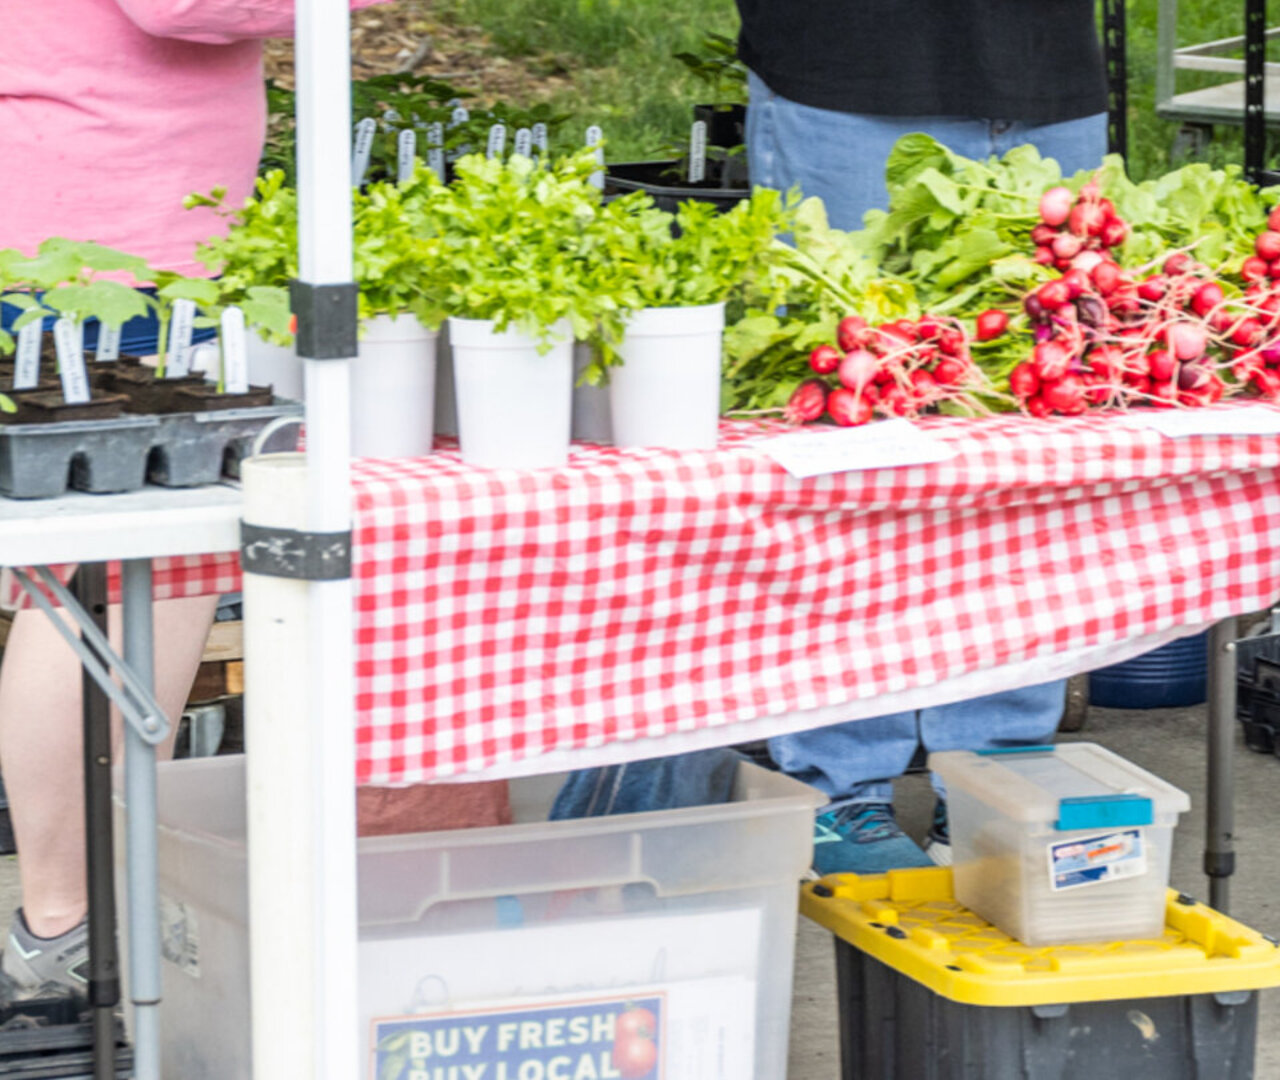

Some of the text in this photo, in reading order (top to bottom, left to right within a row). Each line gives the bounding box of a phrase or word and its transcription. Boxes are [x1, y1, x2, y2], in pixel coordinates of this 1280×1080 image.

[409, 1012, 617, 1060] BUY FRESH
[496, 1051, 622, 1080] LOCAL
